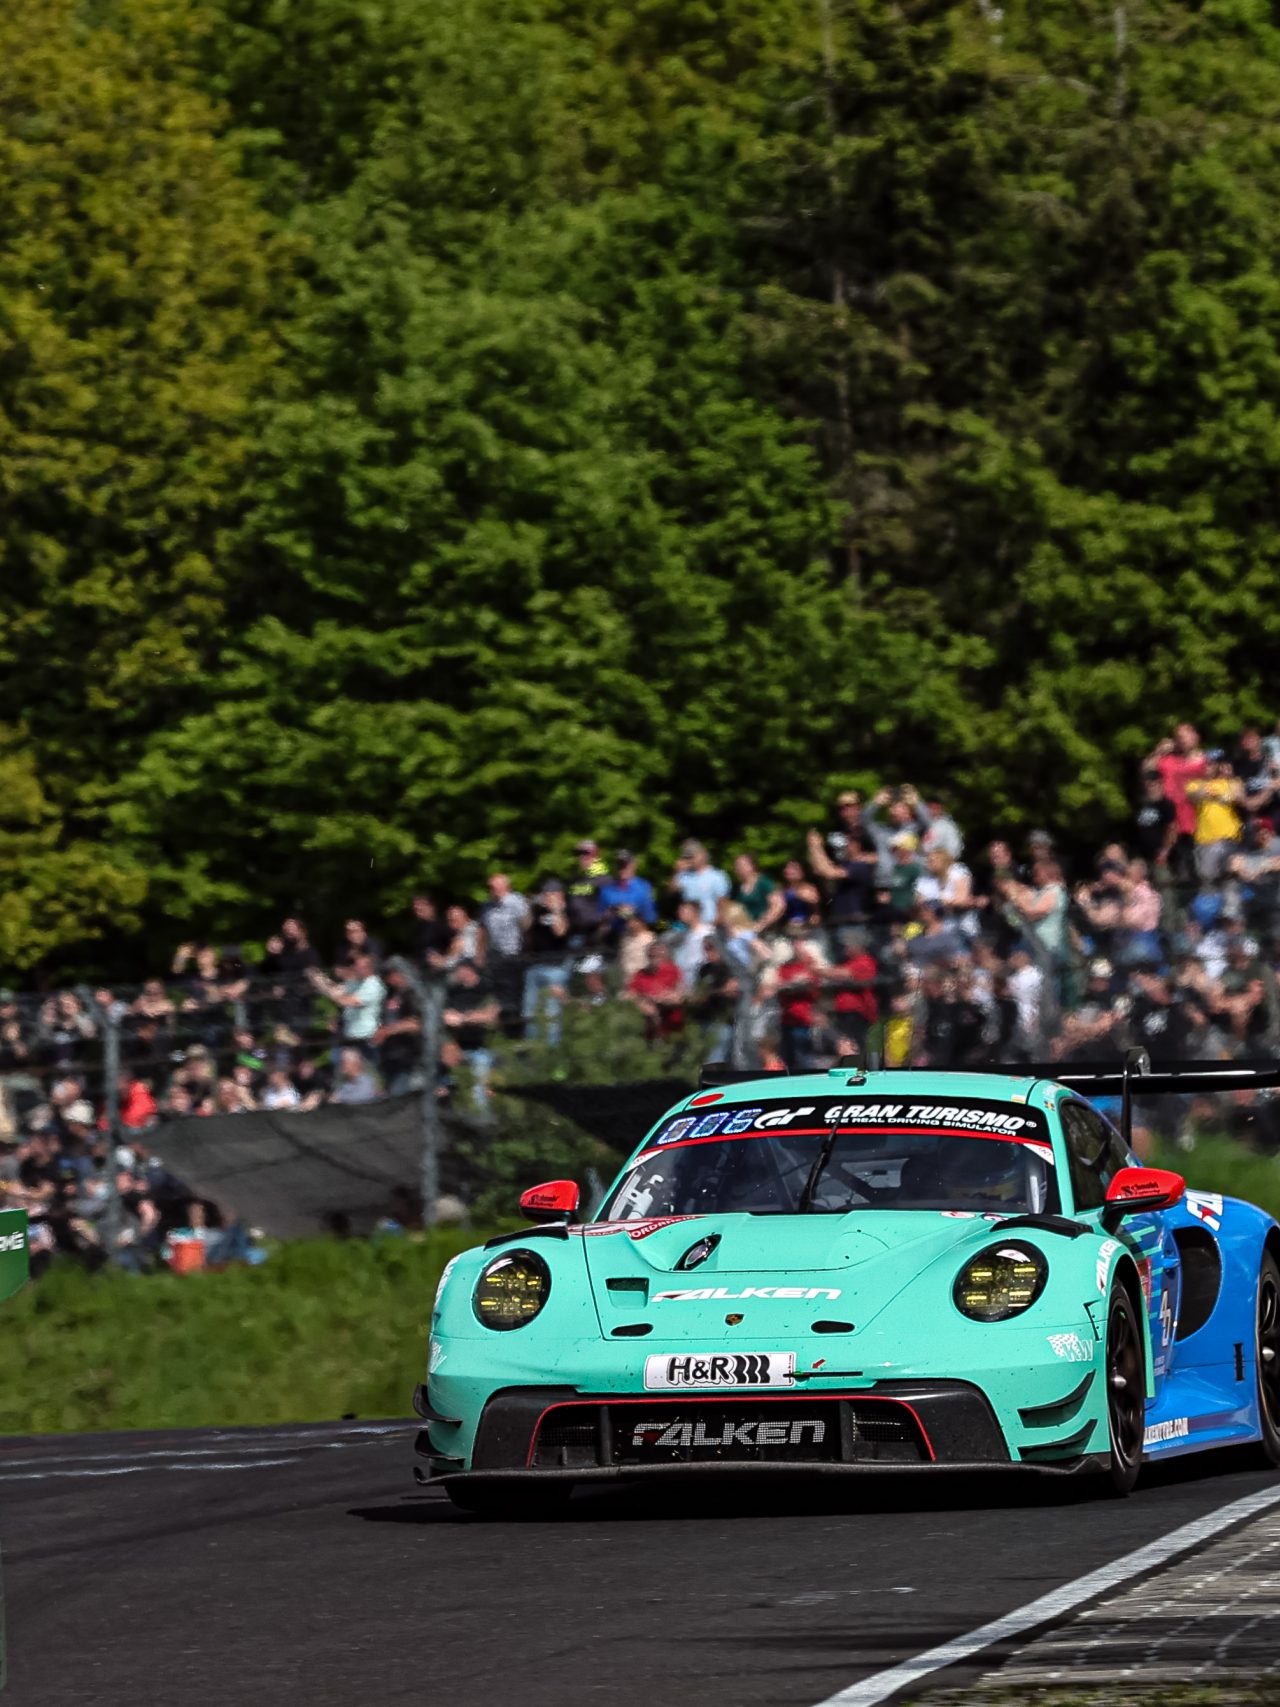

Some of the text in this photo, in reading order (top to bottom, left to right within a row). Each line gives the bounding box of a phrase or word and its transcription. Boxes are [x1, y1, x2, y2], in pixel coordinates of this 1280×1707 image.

[824, 1105, 903, 1119] GRAN
[887, 1117, 940, 1126] DRIVING
[942, 1120, 1017, 1137] SIMULATOR
[650, 1287, 842, 1303] FALKEN
[667, 1356, 732, 1384] H&R
[632, 1419, 826, 1446] FALKEN
